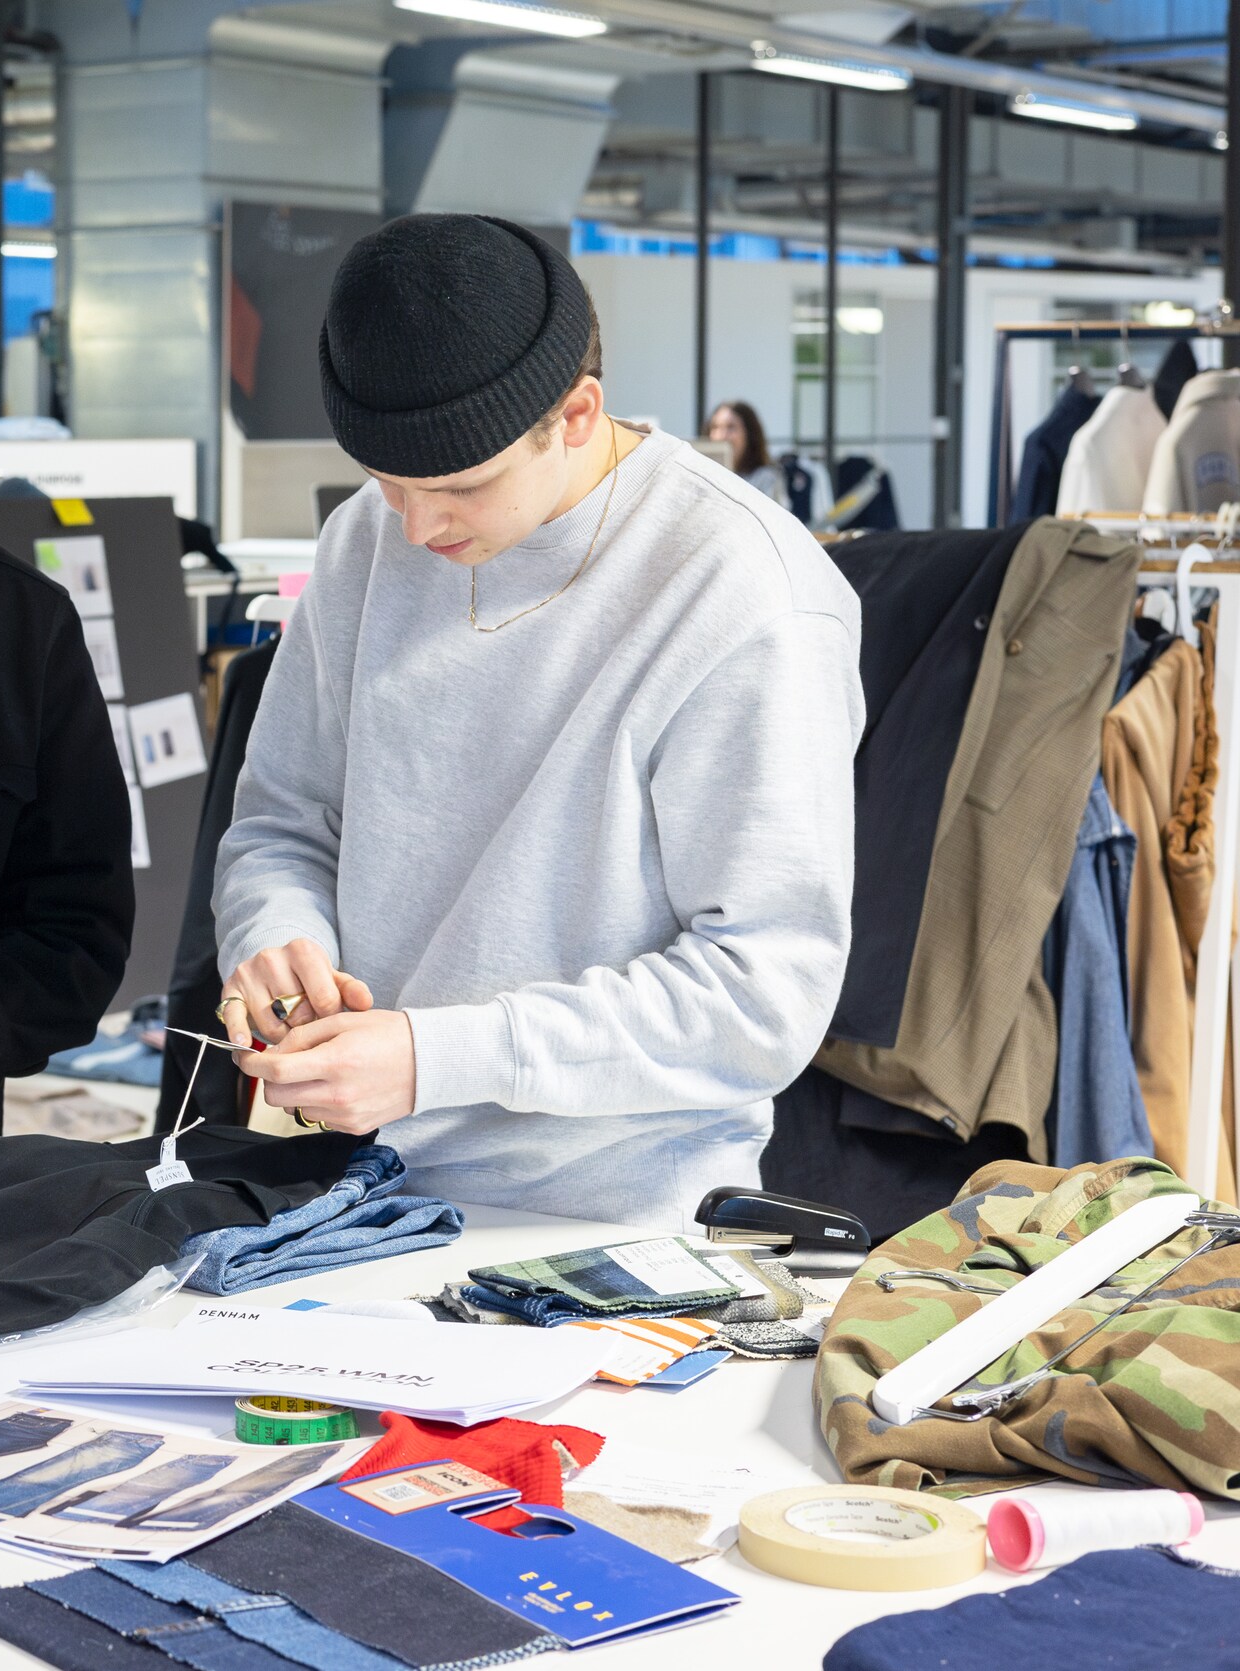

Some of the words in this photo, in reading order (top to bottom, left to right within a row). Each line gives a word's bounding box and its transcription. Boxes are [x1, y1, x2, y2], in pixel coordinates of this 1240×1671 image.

[198, 1309, 261, 1321] DENHAM
[338, 1369, 435, 1382] WMN
[250, 1423, 259, 1437] 143
[264, 1426, 274, 1440] 144
[436, 1471, 473, 1489] ICON
[519, 1571, 614, 1622] EVLOX
